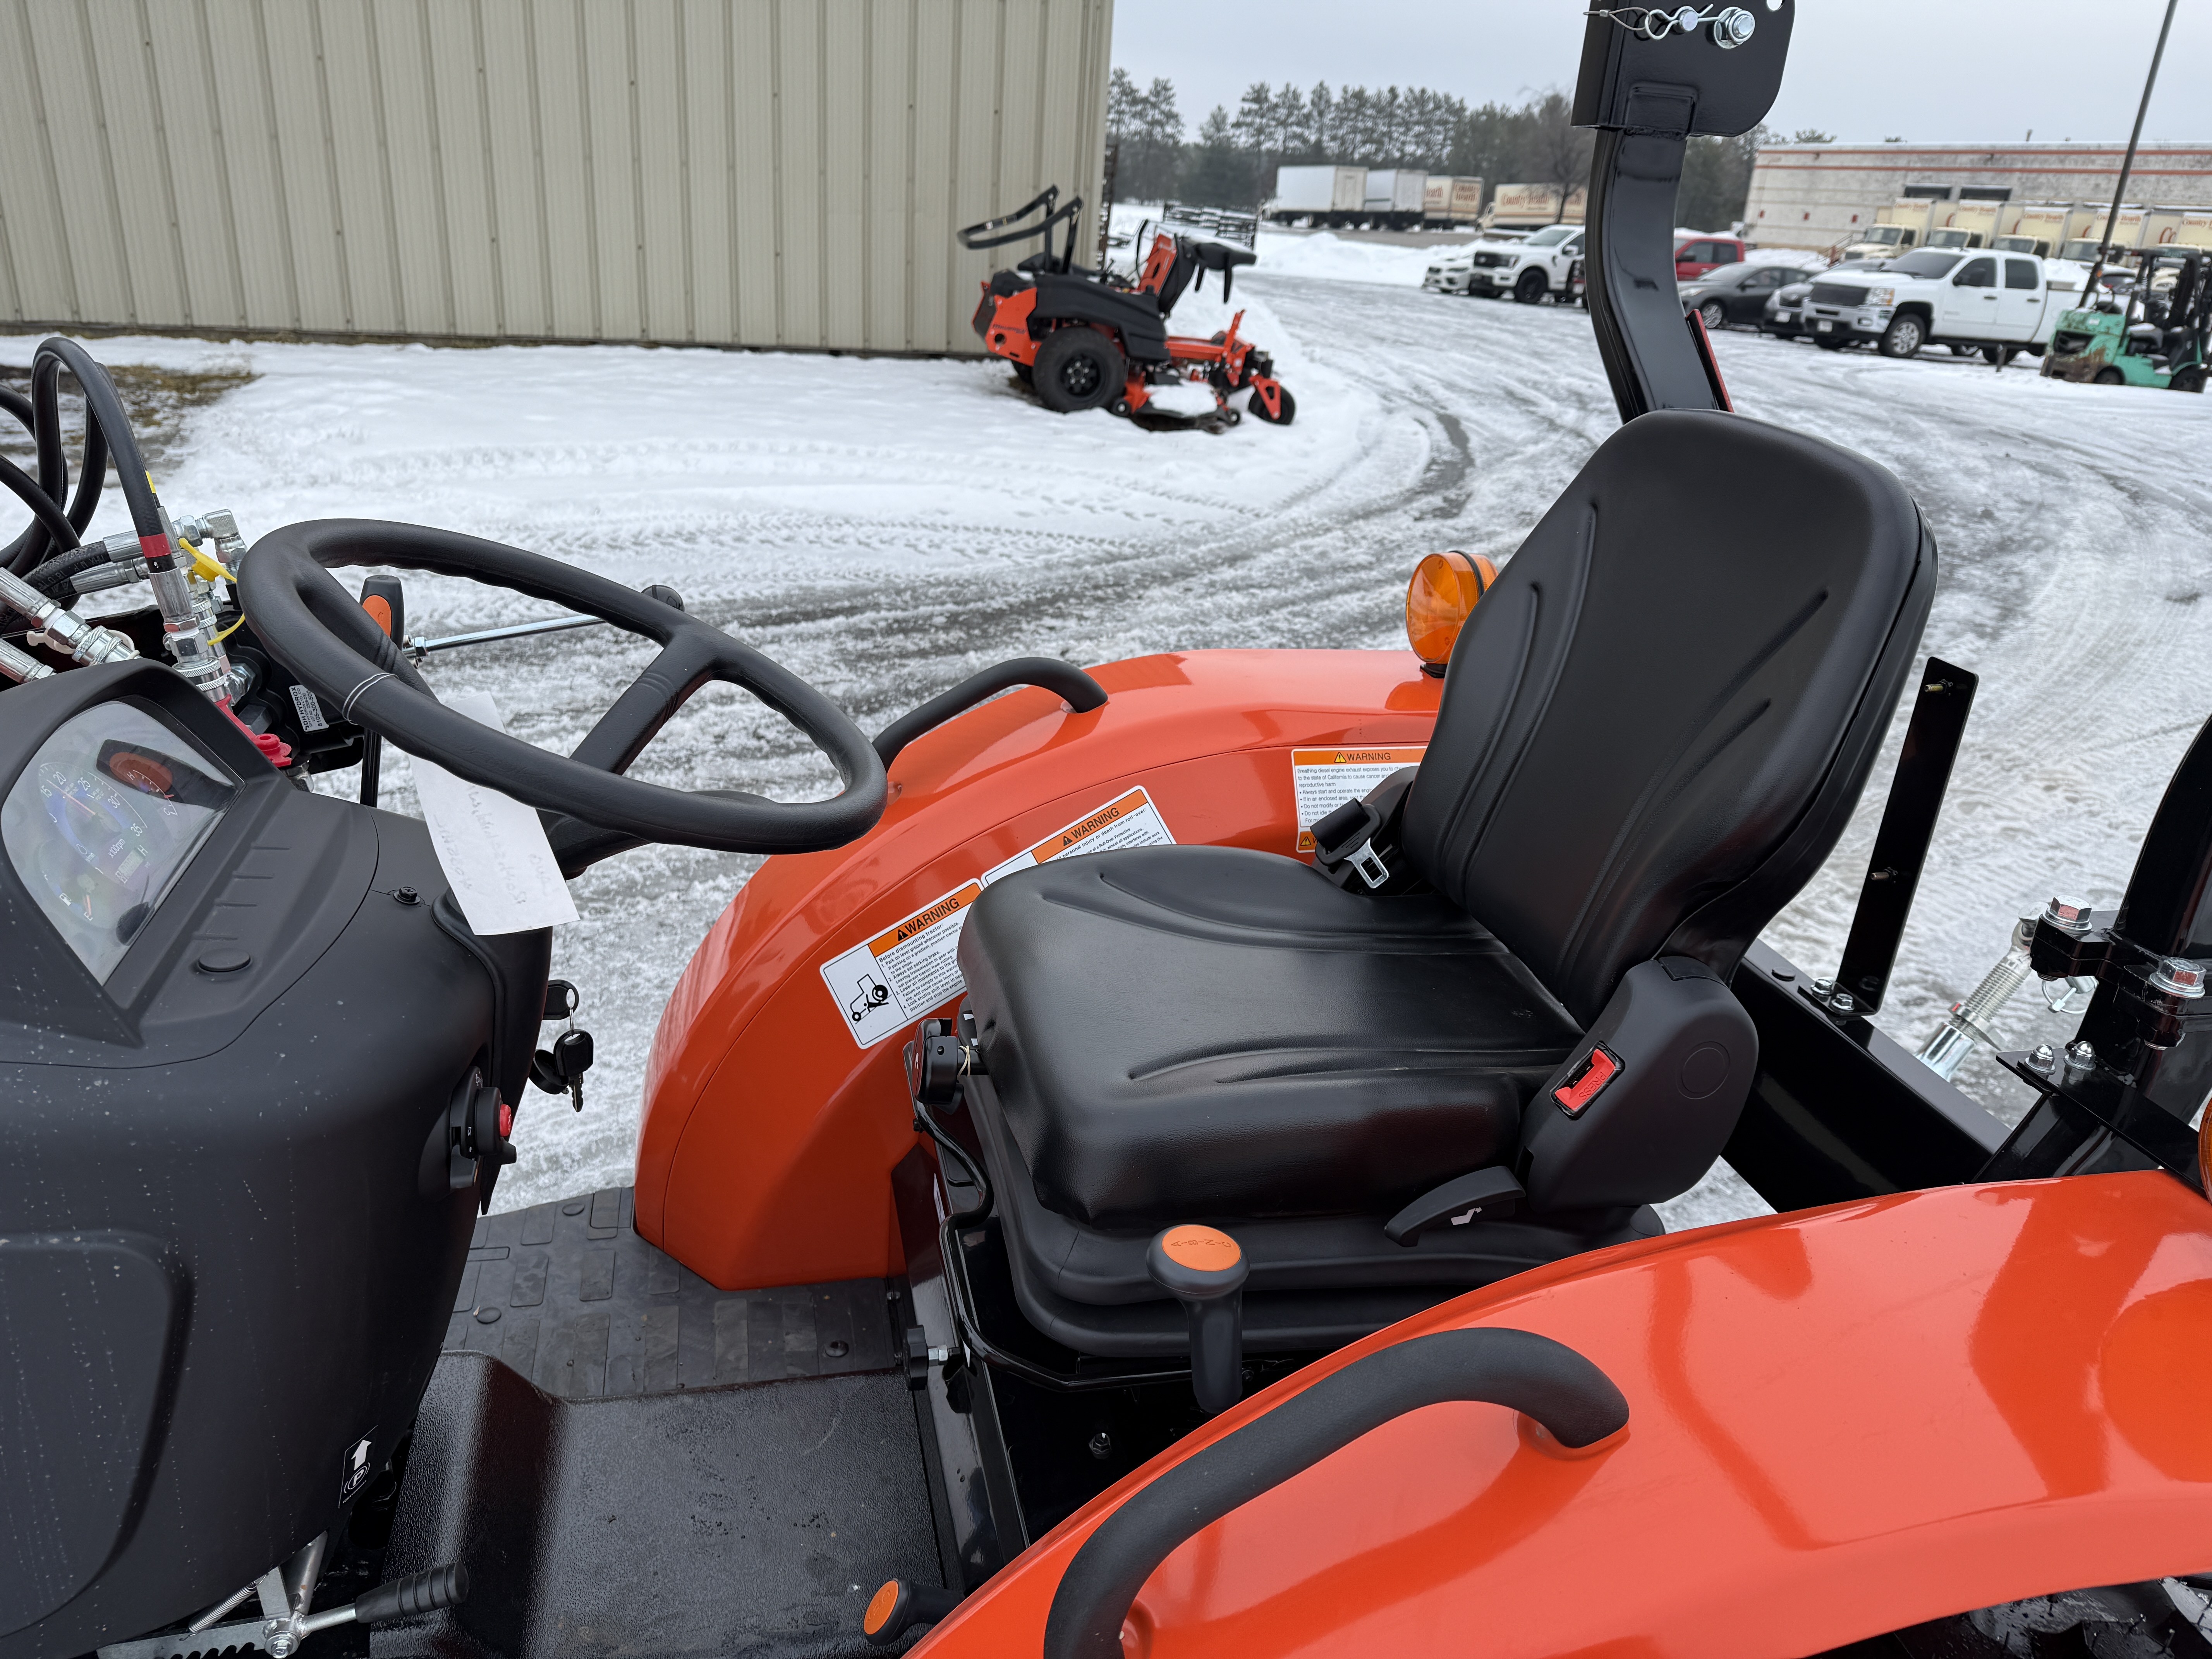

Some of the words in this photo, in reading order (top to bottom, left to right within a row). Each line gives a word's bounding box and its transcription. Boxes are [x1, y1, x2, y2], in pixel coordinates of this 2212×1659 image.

[291, 687, 305, 715] HYDROX
[306, 690, 323, 726] 8105-300-500
[301, 716, 308, 725] DH
[1346, 752, 1391, 761] WARNING
[53, 771, 66, 785] 20
[77, 777, 91, 791] 25
[40, 785, 52, 798] 15
[108, 795, 120, 808] 30
[131, 823, 143, 836] 35
[1062, 845, 1082, 859] personal
[1081, 837, 1095, 847] injury
[1101, 827, 1114, 836] death
[1125, 808, 1147, 822] roll-over:
[1070, 807, 1120, 839] WARNING
[904, 898, 960, 934] WARNING
[879, 951, 895, 963] Before
[895, 934, 926, 953] dismounting
[925, 923, 944, 936] tractor:
[891, 958, 906, 969] parking
[914, 945, 931, 957] gradient,
[930, 936, 946, 947] position
[945, 928, 958, 938] tractor
[900, 949, 910, 957] level
[910, 941, 924, 952] ground
[923, 931, 941, 944] whenever
[941, 922, 960, 934] possible.
[893, 970, 907, 979] Always
[913, 957, 929, 968] parking
[927, 951, 941, 960] brake.
[895, 974, 911, 984] Leaving
[910, 960, 934, 976] transmission
[902, 961, 914, 969] slope.
[905, 974, 919, 986] prevent
[918, 968, 931, 977] tractor
[940, 955, 954, 964] rolling.
[900, 984, 912, 993] Lower
[917, 969, 940, 983] implements
[902, 988, 916, 998] Failure
[920, 978, 934, 988] comply
[917, 992, 931, 1001] shuttle
[931, 986, 941, 994] shift
[939, 980, 950, 988] lever
[921, 984, 932, 993] could
[932, 979, 943, 987] cause
[943, 972, 954, 981] injury
[910, 1001, 926, 1012] position
[949, 980, 964, 989] engine.
[1579, 1072, 1607, 1100] PRESS
